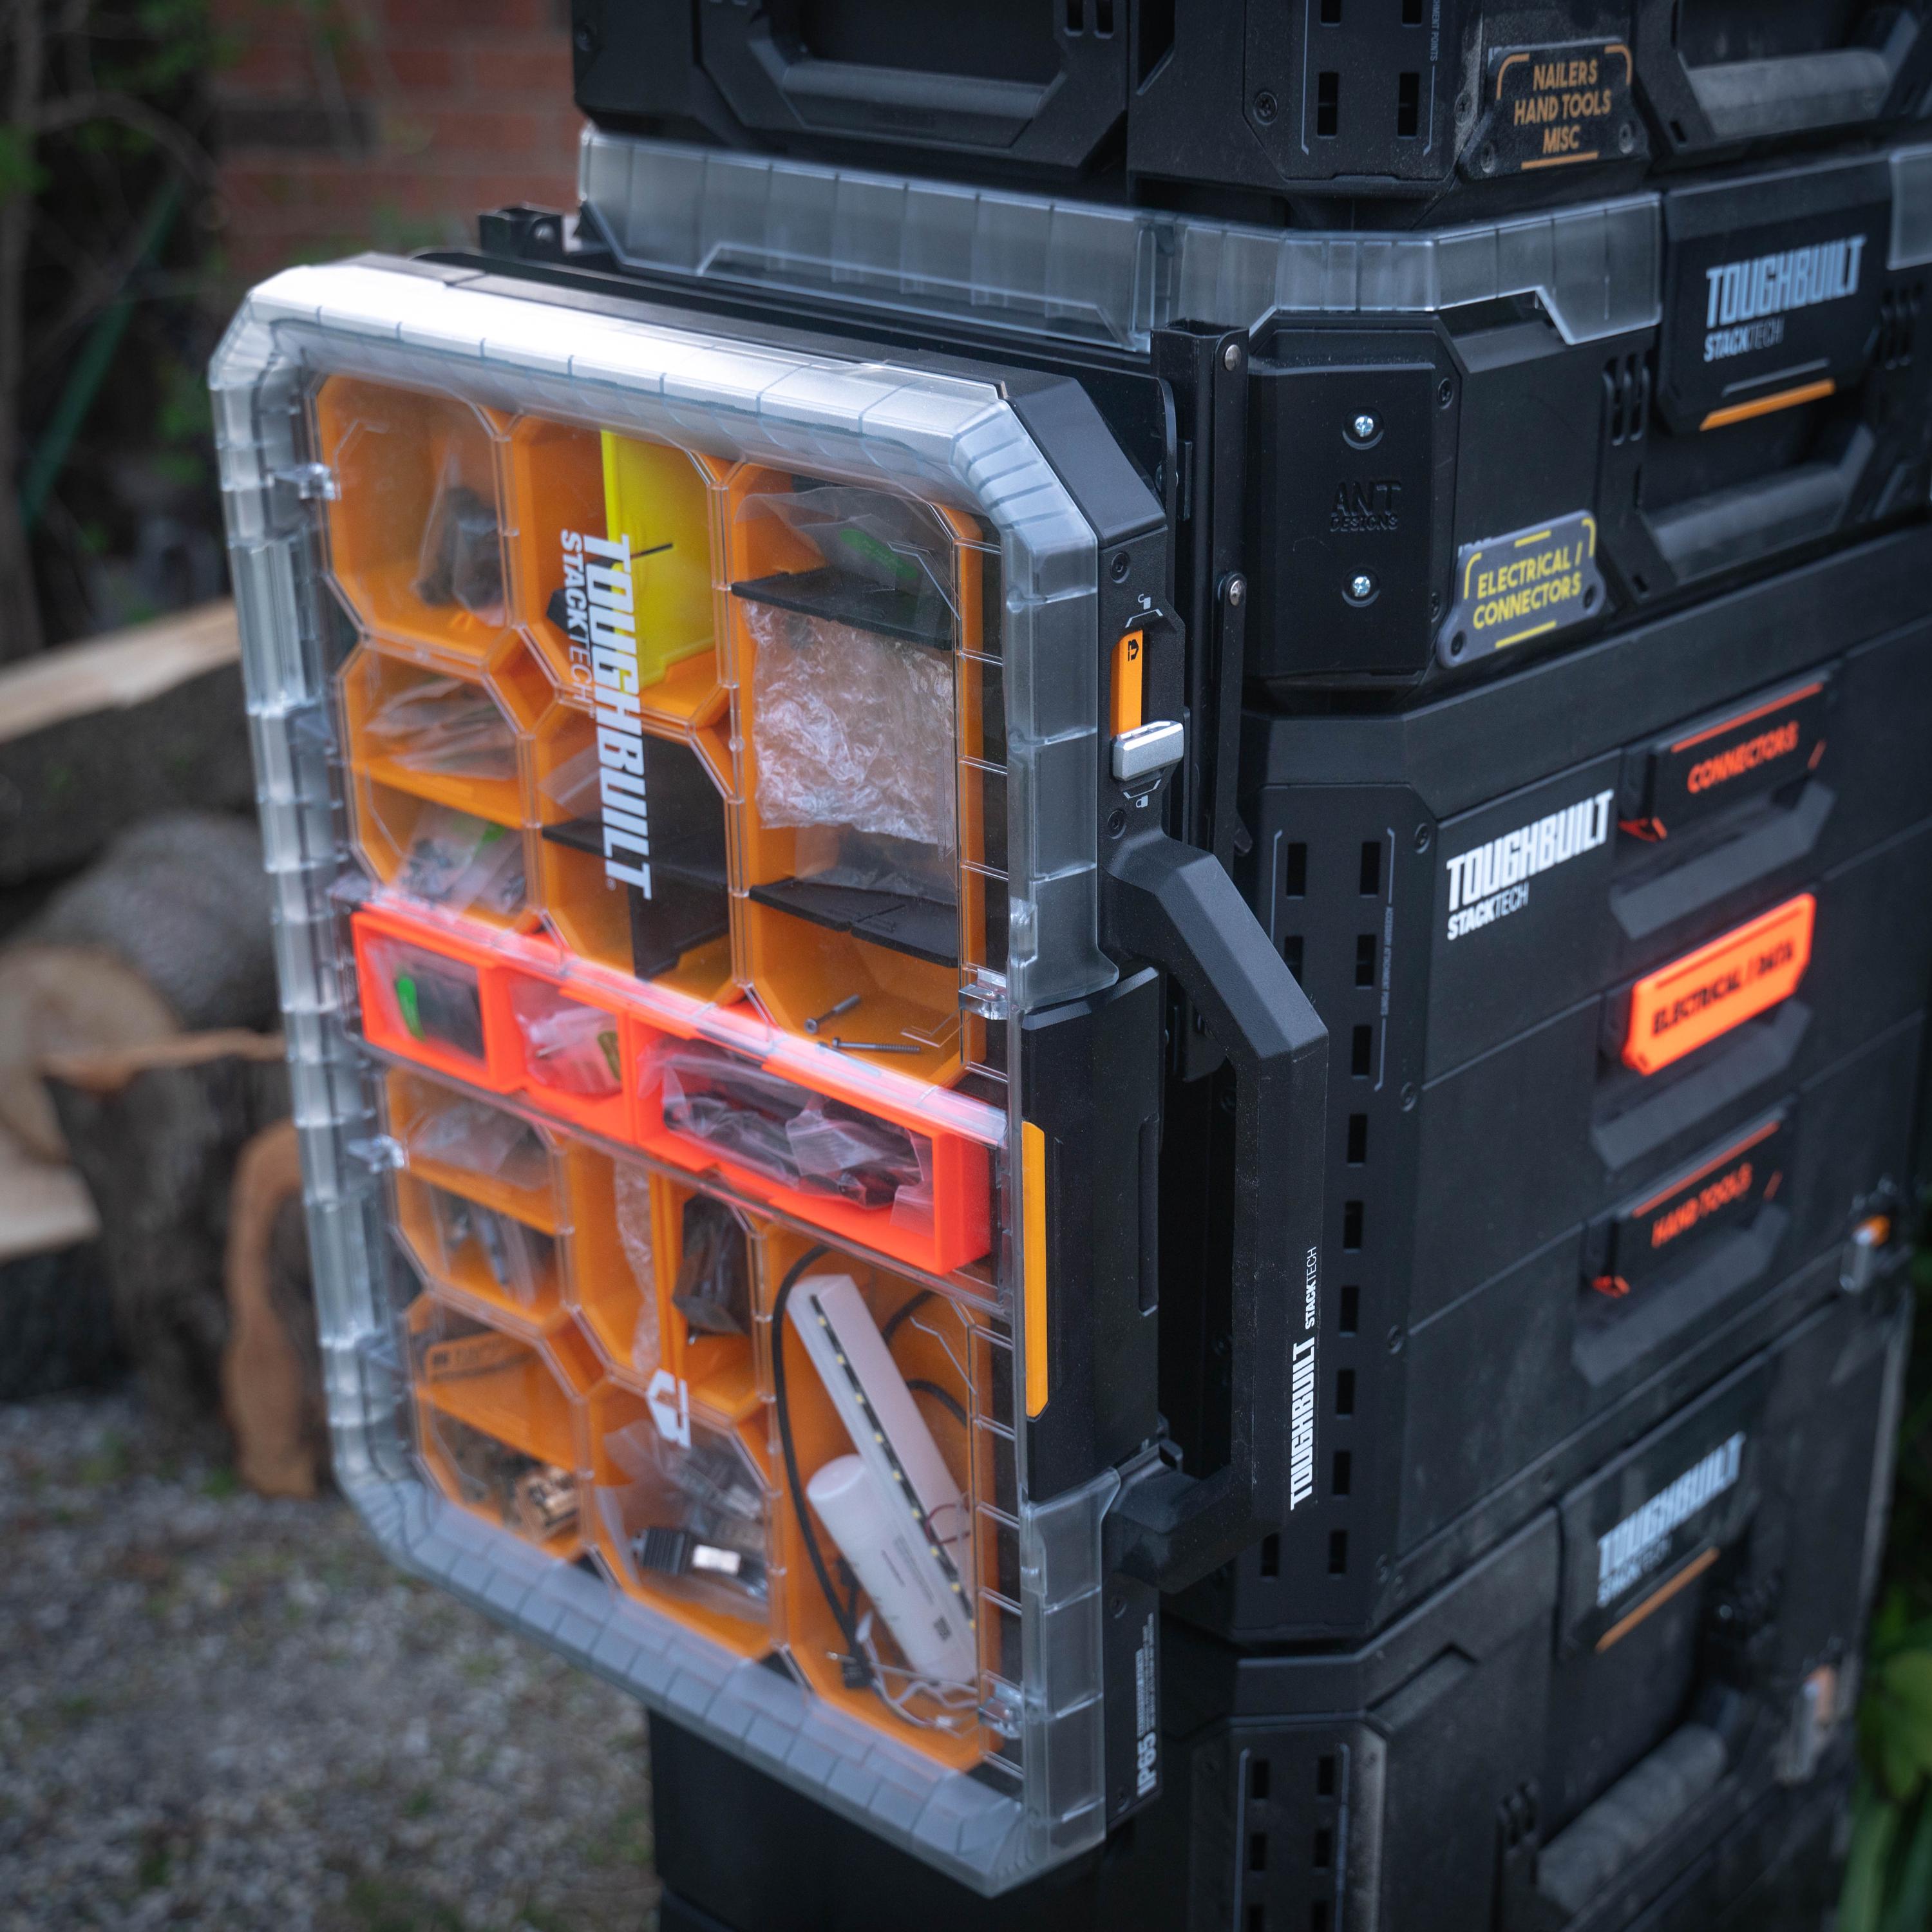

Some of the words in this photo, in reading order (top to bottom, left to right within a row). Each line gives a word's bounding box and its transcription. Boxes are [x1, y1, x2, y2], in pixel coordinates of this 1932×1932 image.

[1430, 31, 1439, 61] POINTS
[1533, 60, 1597, 91] NAILERS
[1514, 98, 1559, 126] HAND
[1562, 90, 1611, 117] TOOLS
[1543, 126, 1580, 153] MISC
[1707, 234, 1866, 328] TOUGHBUILT
[1705, 318, 1784, 362] STACKTECH
[1329, 516, 1398, 533] DESIGNS
[1333, 480, 1401, 515] ANT
[1473, 572, 1582, 630] CONNECTORS
[1478, 546, 1571, 600] ELECTRICAL
[583, 533, 652, 900] TOUGHBUILT
[1687, 721, 1798, 793] CONNECTORS
[1446, 789, 1613, 911] TOUGHBUILT
[1448, 882, 1529, 940] STACKTECH
[1290, 1336, 1314, 1511] TOUGHBUILT
[1305, 1246, 1318, 1329] STACKTECH
[1137, 1731, 1157, 1796] IP65
